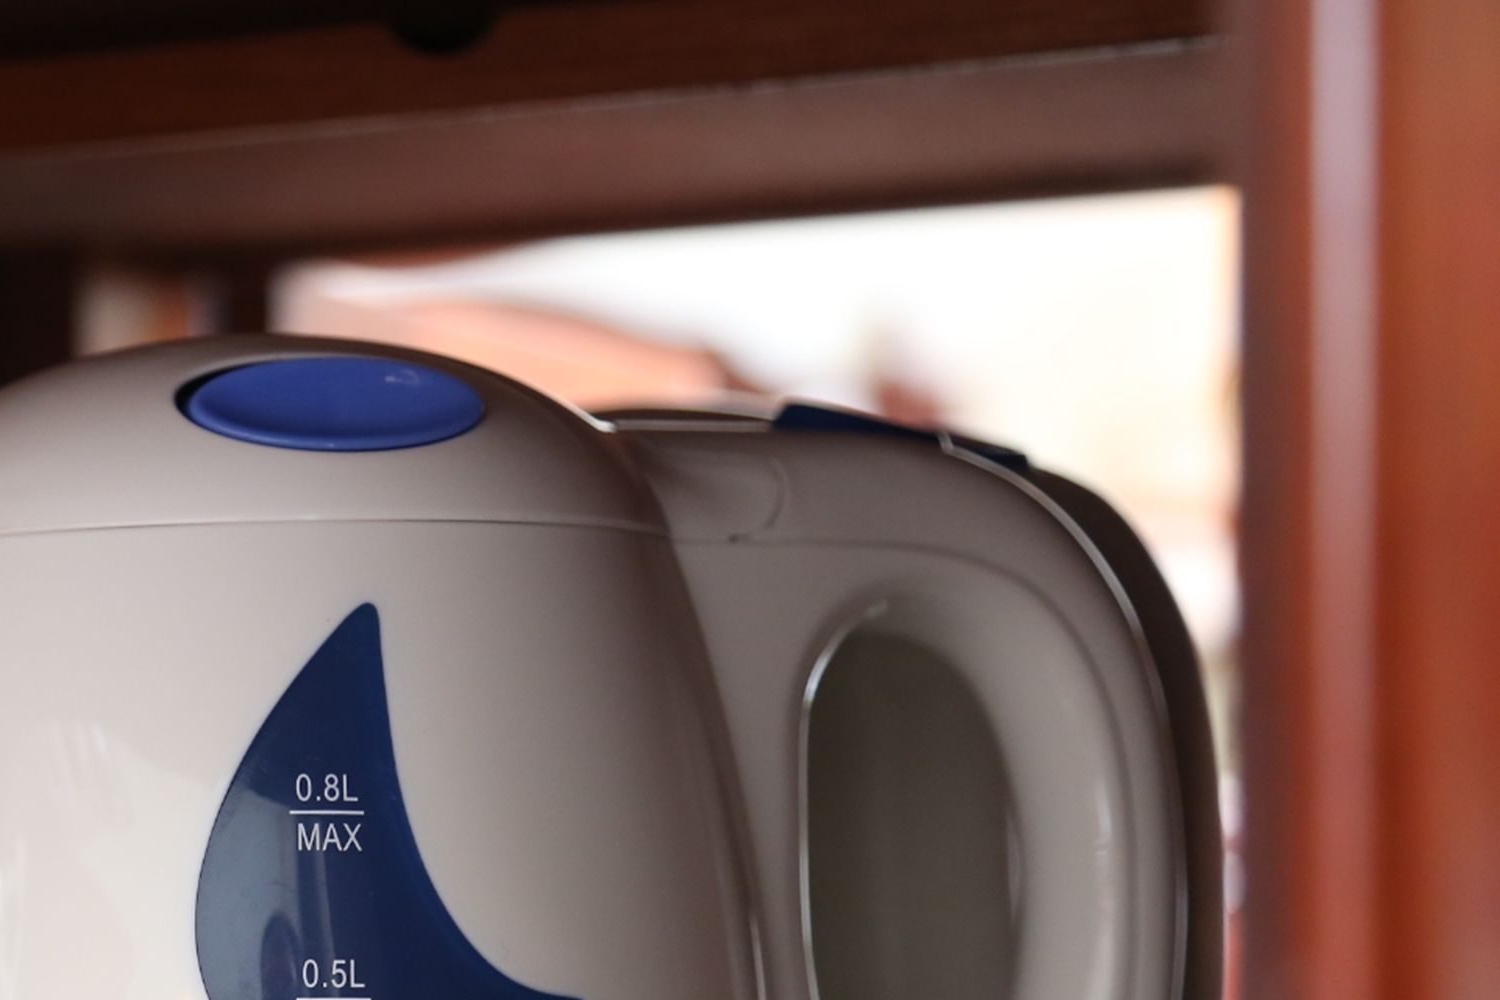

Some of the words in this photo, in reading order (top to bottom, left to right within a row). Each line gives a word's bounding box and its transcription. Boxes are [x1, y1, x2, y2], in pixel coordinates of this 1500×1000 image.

[295, 773, 359, 802] 0.8L
[297, 822, 363, 852] MAX
[302, 958, 366, 989] 0.5L
